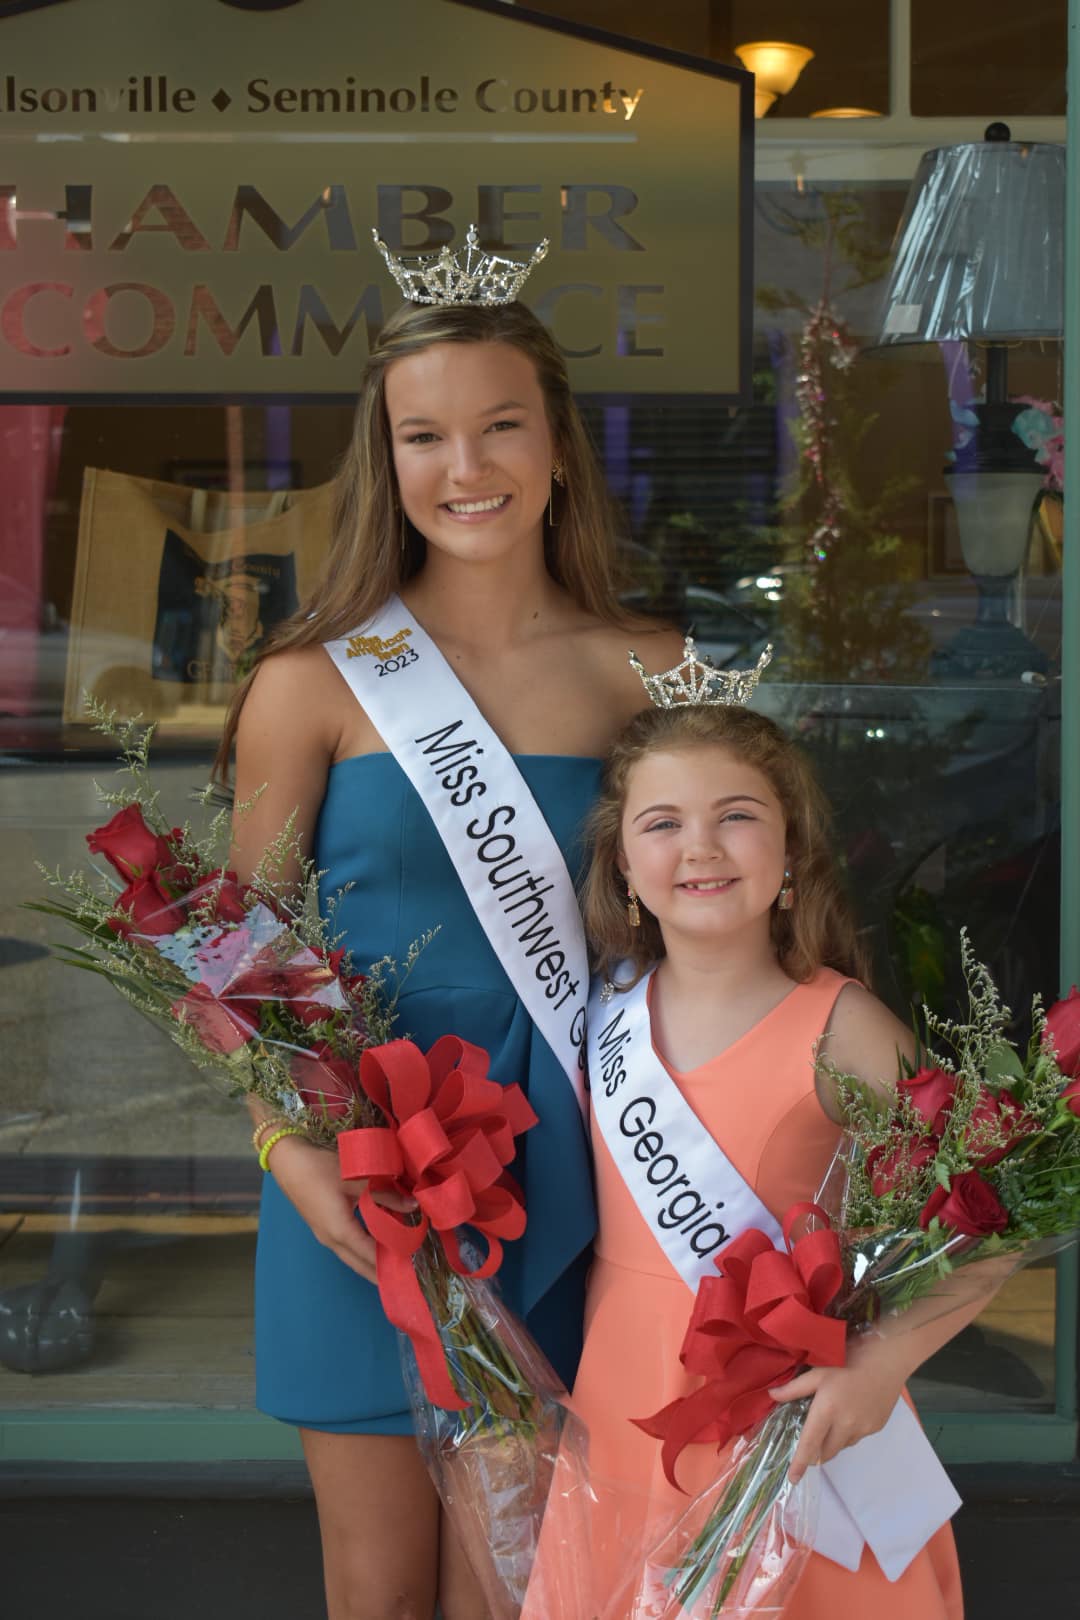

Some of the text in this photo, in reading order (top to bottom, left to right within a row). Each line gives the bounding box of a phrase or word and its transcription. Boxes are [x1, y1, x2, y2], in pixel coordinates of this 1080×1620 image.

[0, 75, 645, 120] lsonville Seminole County
[2, 282, 665, 359] COMMCE
[374, 648, 419, 677] 2023
[415, 719, 486, 807] Miss
[466, 805, 581, 1011] Southwest
[597, 1007, 731, 1260] Miss Georgia
